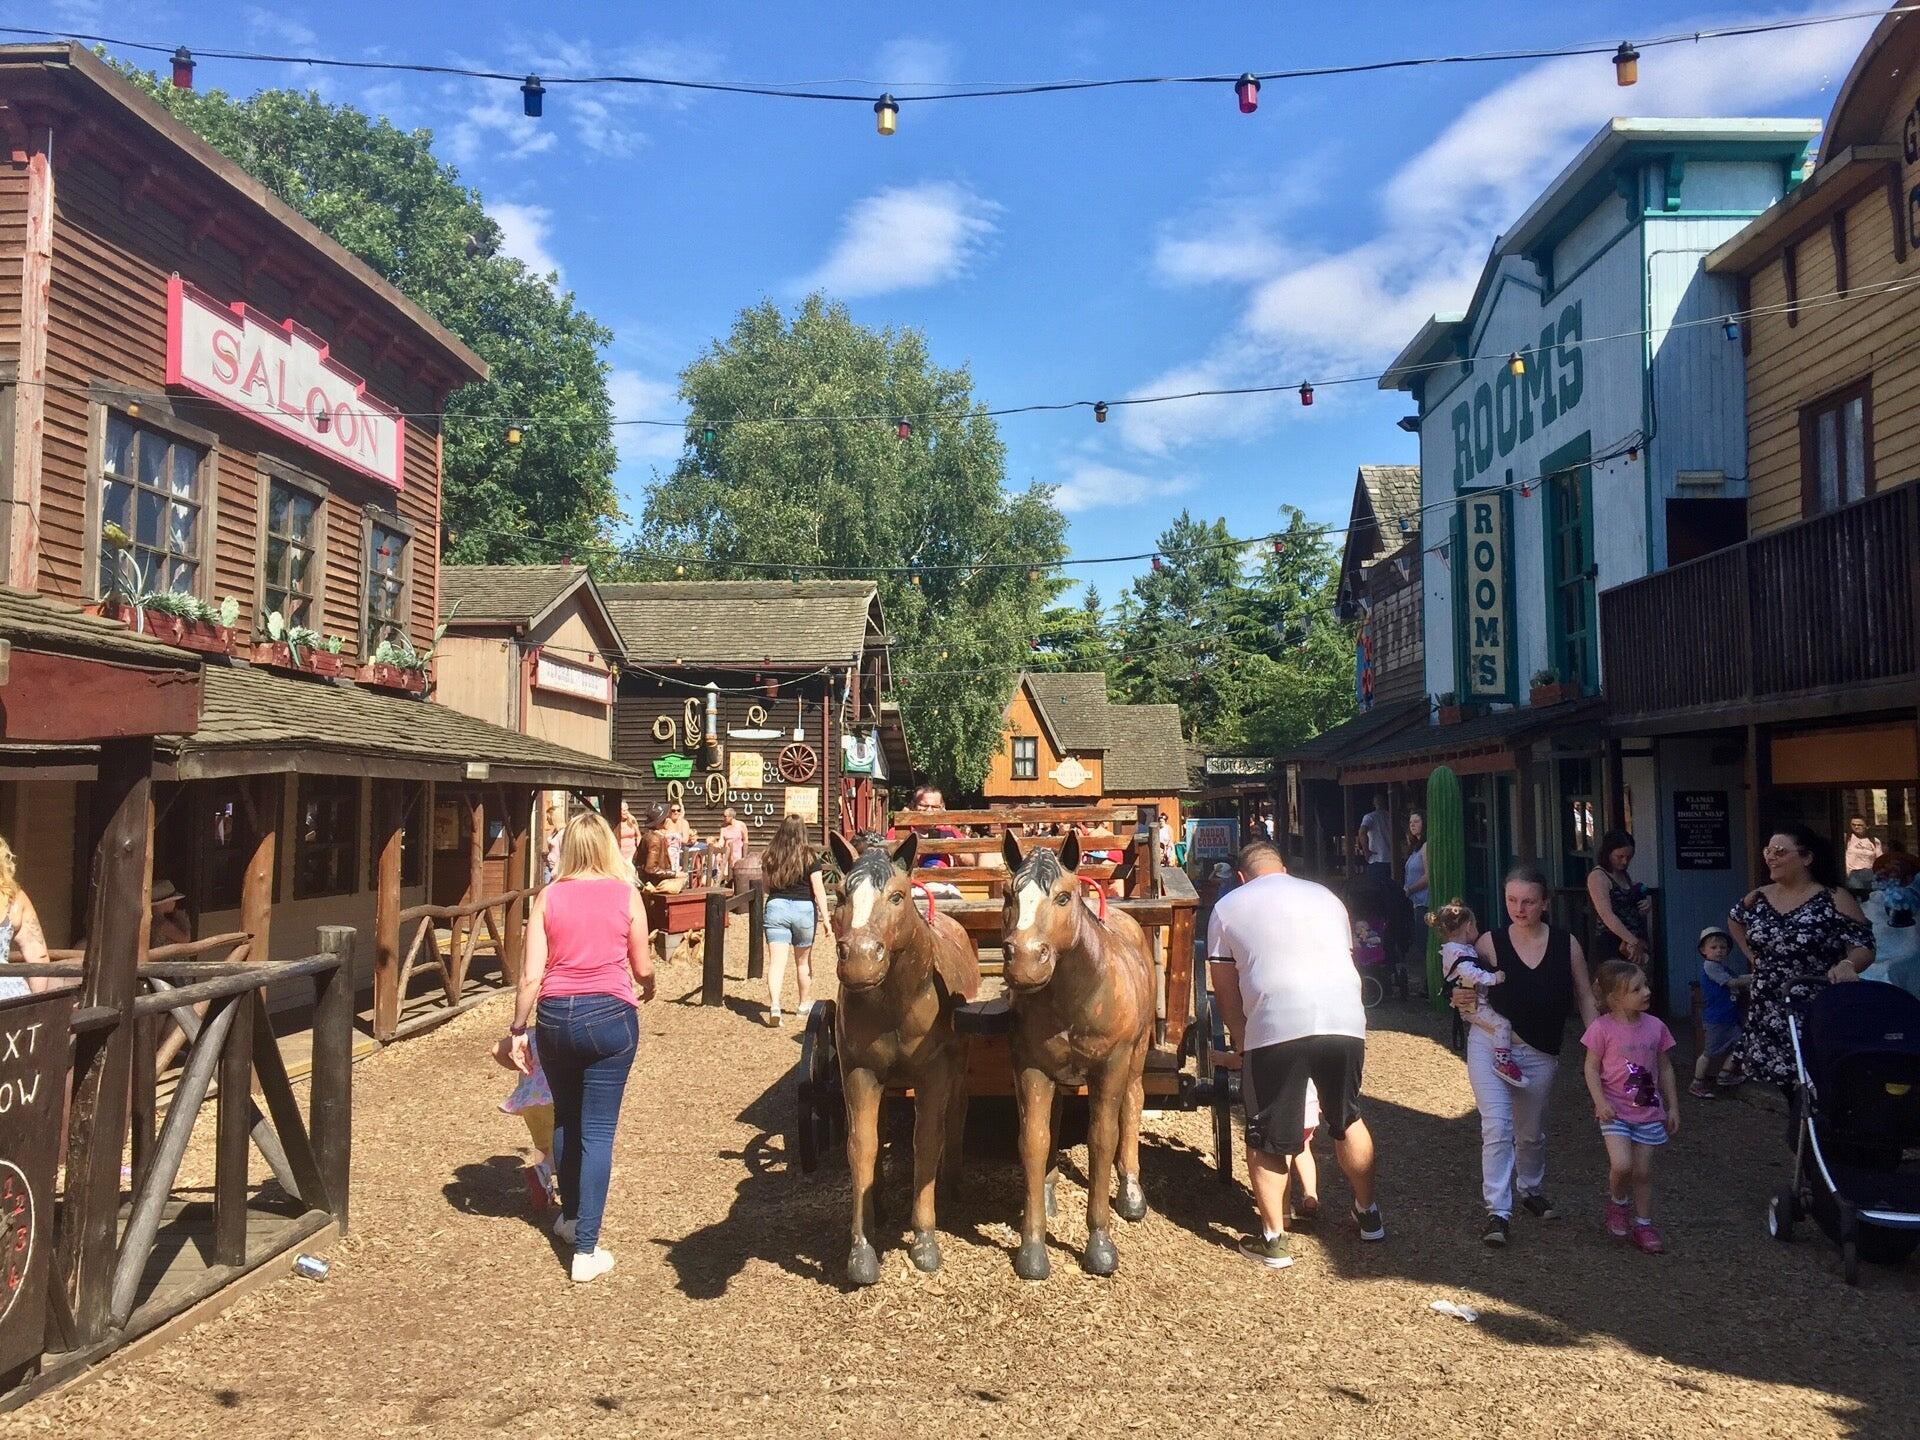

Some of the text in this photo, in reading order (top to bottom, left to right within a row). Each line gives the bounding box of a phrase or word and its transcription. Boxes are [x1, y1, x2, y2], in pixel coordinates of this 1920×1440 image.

[212, 329, 378, 465] SALOON
[1451, 299, 1583, 491] ROOMS
[1473, 502, 1500, 687] ROOMS
[1197, 837, 1229, 847] CORRAL
[1200, 827, 1225, 838] RODEO
